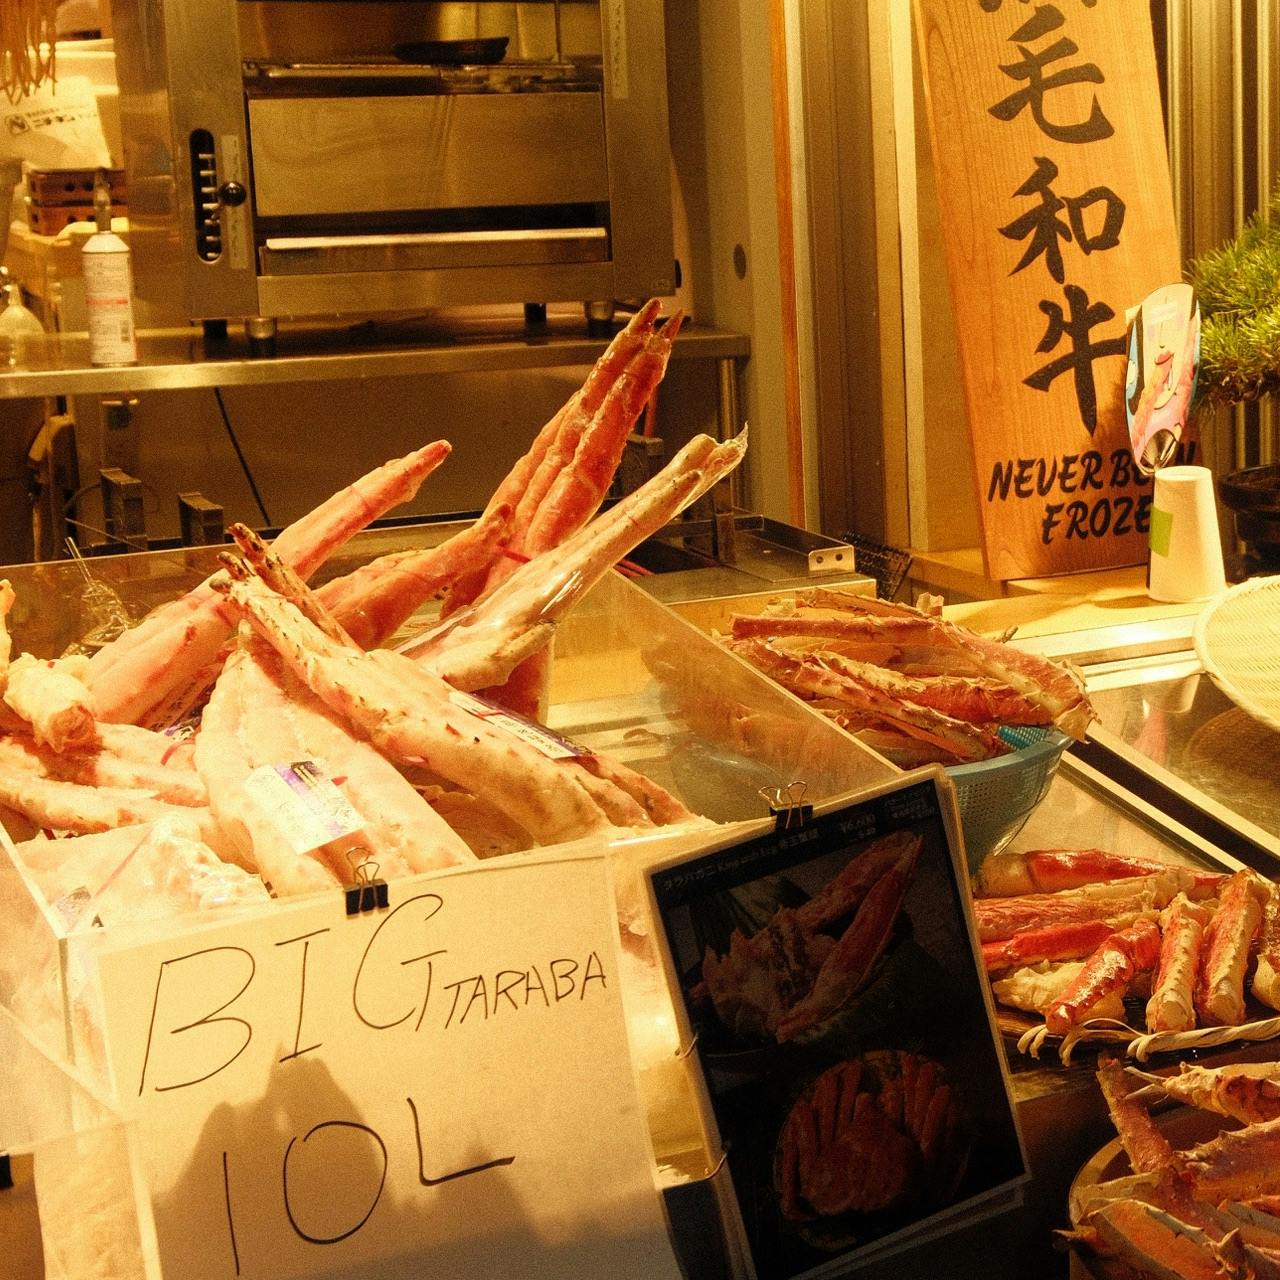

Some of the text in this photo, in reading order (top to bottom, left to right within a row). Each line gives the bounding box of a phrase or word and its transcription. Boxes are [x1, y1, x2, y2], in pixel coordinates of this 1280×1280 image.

[988, 450, 1104, 502] NEVER
[1042, 495, 1151, 546] FROZE
[139, 893, 607, 1097] BIG TARABA
